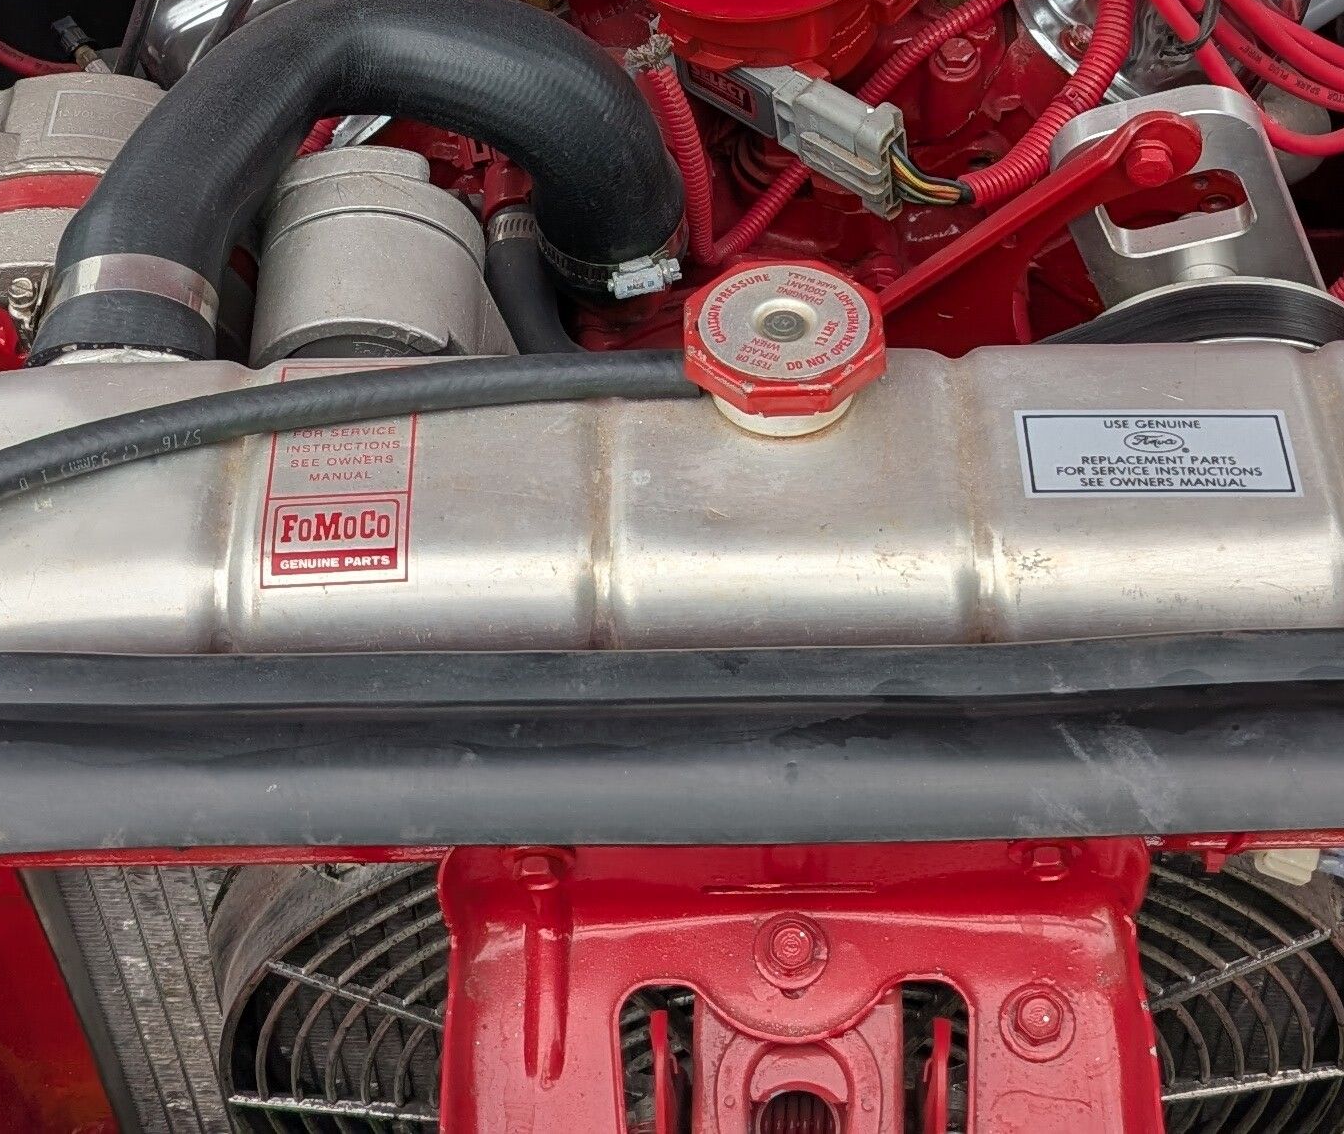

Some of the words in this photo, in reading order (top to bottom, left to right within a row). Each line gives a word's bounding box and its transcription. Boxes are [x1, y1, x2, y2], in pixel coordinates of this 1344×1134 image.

[1268, 64, 1289, 80] PLUG
[1296, 80, 1320, 95] SPARK
[785, 279, 827, 296] COOLANT
[776, 286, 824, 305] CHANGING
[707, 304, 726, 343] CAUTION
[718, 273, 770, 307] PRESSURE
[752, 337, 779, 351] WHEN
[741, 345, 780, 361] REPLACE
[752, 359, 772, 370] TEST
[786, 361, 802, 370] DO
[806, 353, 830, 367] NOT
[1103, 419, 1130, 430] USE
[1134, 419, 1202, 430] GENUINE
[292, 427, 324, 438] FOR
[330, 426, 397, 437] SERVICE
[286, 440, 401, 453] INSTRUCTIONS
[290, 458, 320, 468] SEE
[326, 454, 394, 466] OWNERS
[1081, 456, 1184, 466] REPLACEMENT
[1190, 456, 1237, 466] PARTS
[308, 471, 373, 482] MANUAL
[1056, 466, 1086, 476] FOR
[1091, 466, 1150, 476] SERVICE
[1155, 466, 1263, 477] INSTRUCTIONS
[1080, 477, 1105, 487] SEE
[1109, 477, 1175, 488] OWNERS
[1179, 477, 1247, 488] MANUAL
[280, 510, 390, 543] FoMoCo
[279, 556, 340, 570] GENUINE
[344, 555, 391, 567] PARTS
